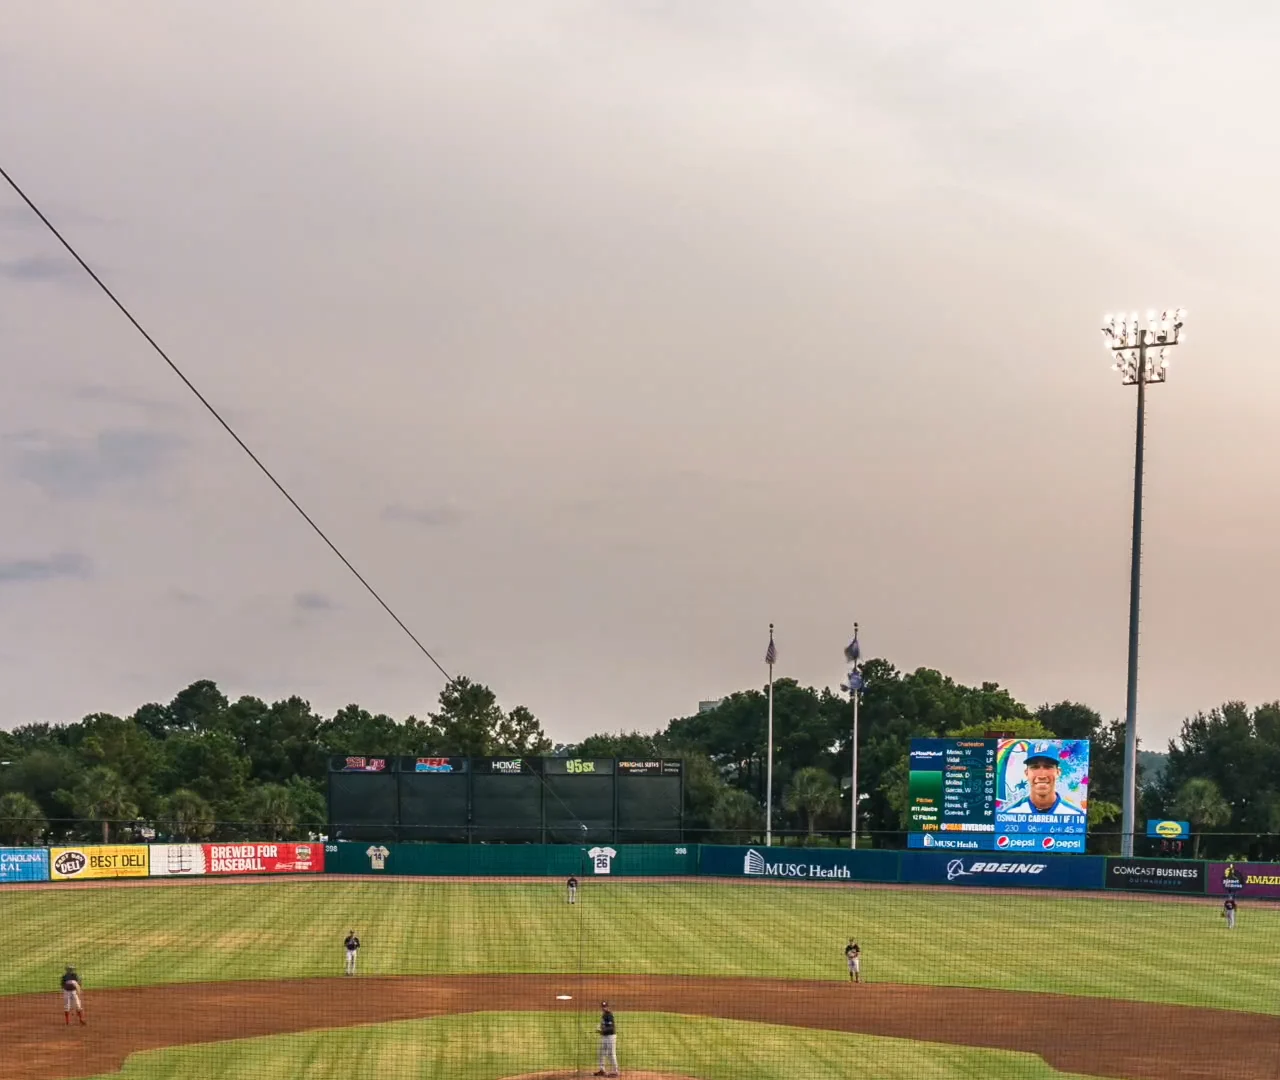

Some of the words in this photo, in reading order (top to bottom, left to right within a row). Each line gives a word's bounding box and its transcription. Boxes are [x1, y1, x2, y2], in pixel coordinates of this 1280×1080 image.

[491, 760, 522, 770] HOME
[996, 814, 1027, 823] OSWALDO
[1028, 814, 1058, 823] CABRERA
[1076, 815, 1085, 824] 10
[922, 823, 939, 831] MPH
[1004, 824, 1019, 832] 230
[1027, 825, 1037, 833] 96
[934, 840, 956, 848] MUSC
[1010, 838, 1036, 847] pepsi
[1056, 839, 1081, 848] pepsi
[211, 845, 255, 859] BREWED
[257, 845, 278, 858] FOR
[373, 852, 382, 860] 14
[0, 853, 41, 863] CAROLINA
[90, 855, 118, 868] BEST
[121, 854, 145, 867] DELI
[596, 858, 608, 868] 26
[60, 860, 80, 873] DELI
[211, 857, 266, 872] BASEBALL.
[969, 862, 1045, 874] BOEING
[765, 863, 807, 877] MUSC
[808, 864, 851, 878] Health
[1113, 866, 1155, 876] COMCAST
[1156, 868, 1198, 878] BUSINESS
